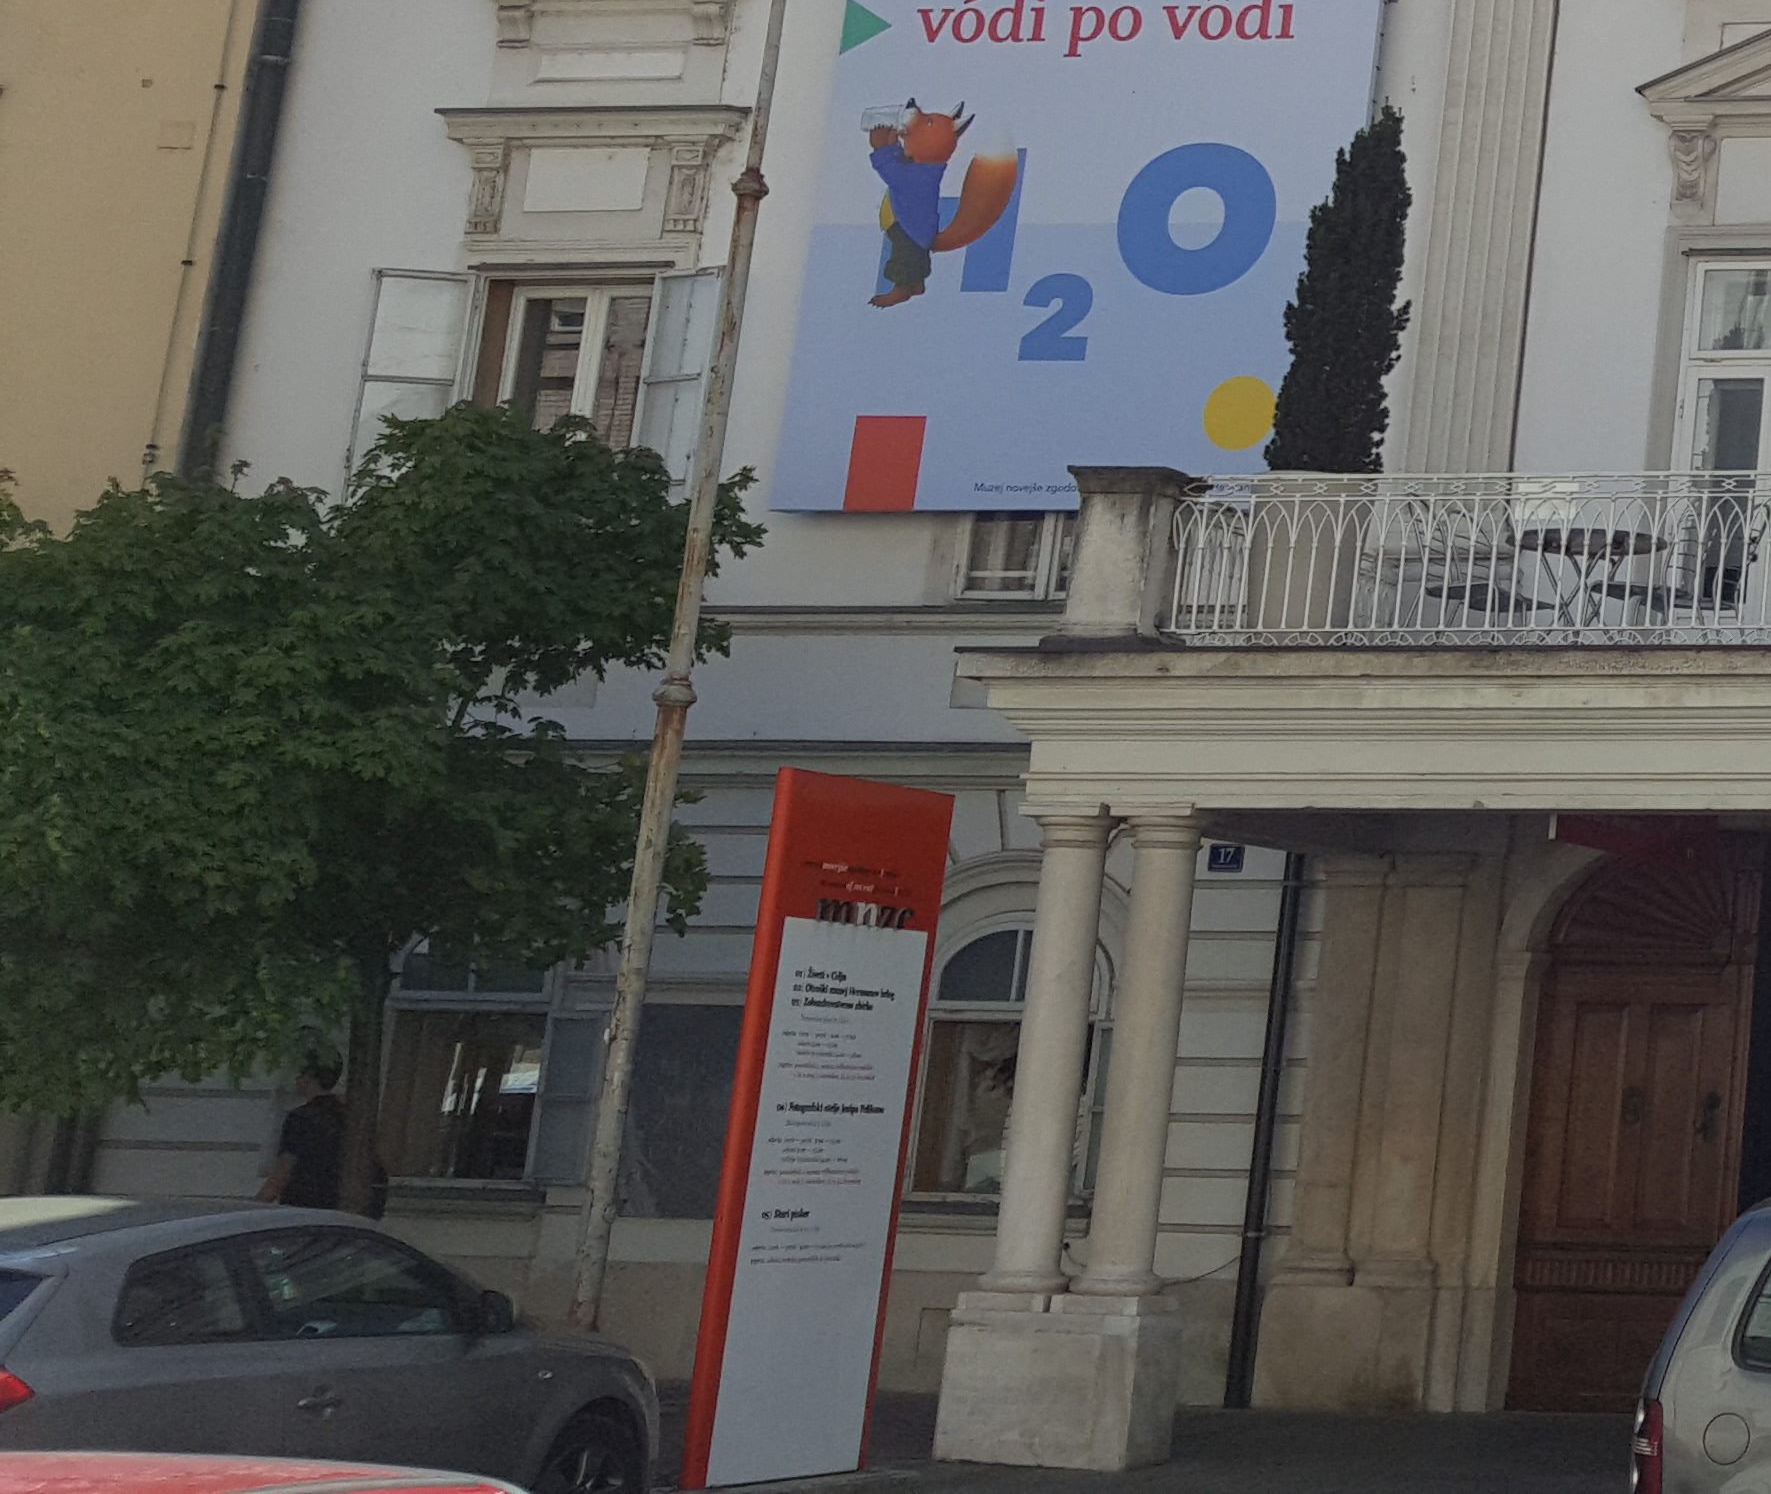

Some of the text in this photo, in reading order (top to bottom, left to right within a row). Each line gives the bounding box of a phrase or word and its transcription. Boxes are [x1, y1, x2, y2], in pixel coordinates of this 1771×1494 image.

[1062, 3, 1143, 58] po
[973, 482, 1003, 494] Muzej
[1005, 482, 1043, 495] novejše
[1045, 482, 1077, 495] zgodo
[1218, 847, 1236, 864] 17
